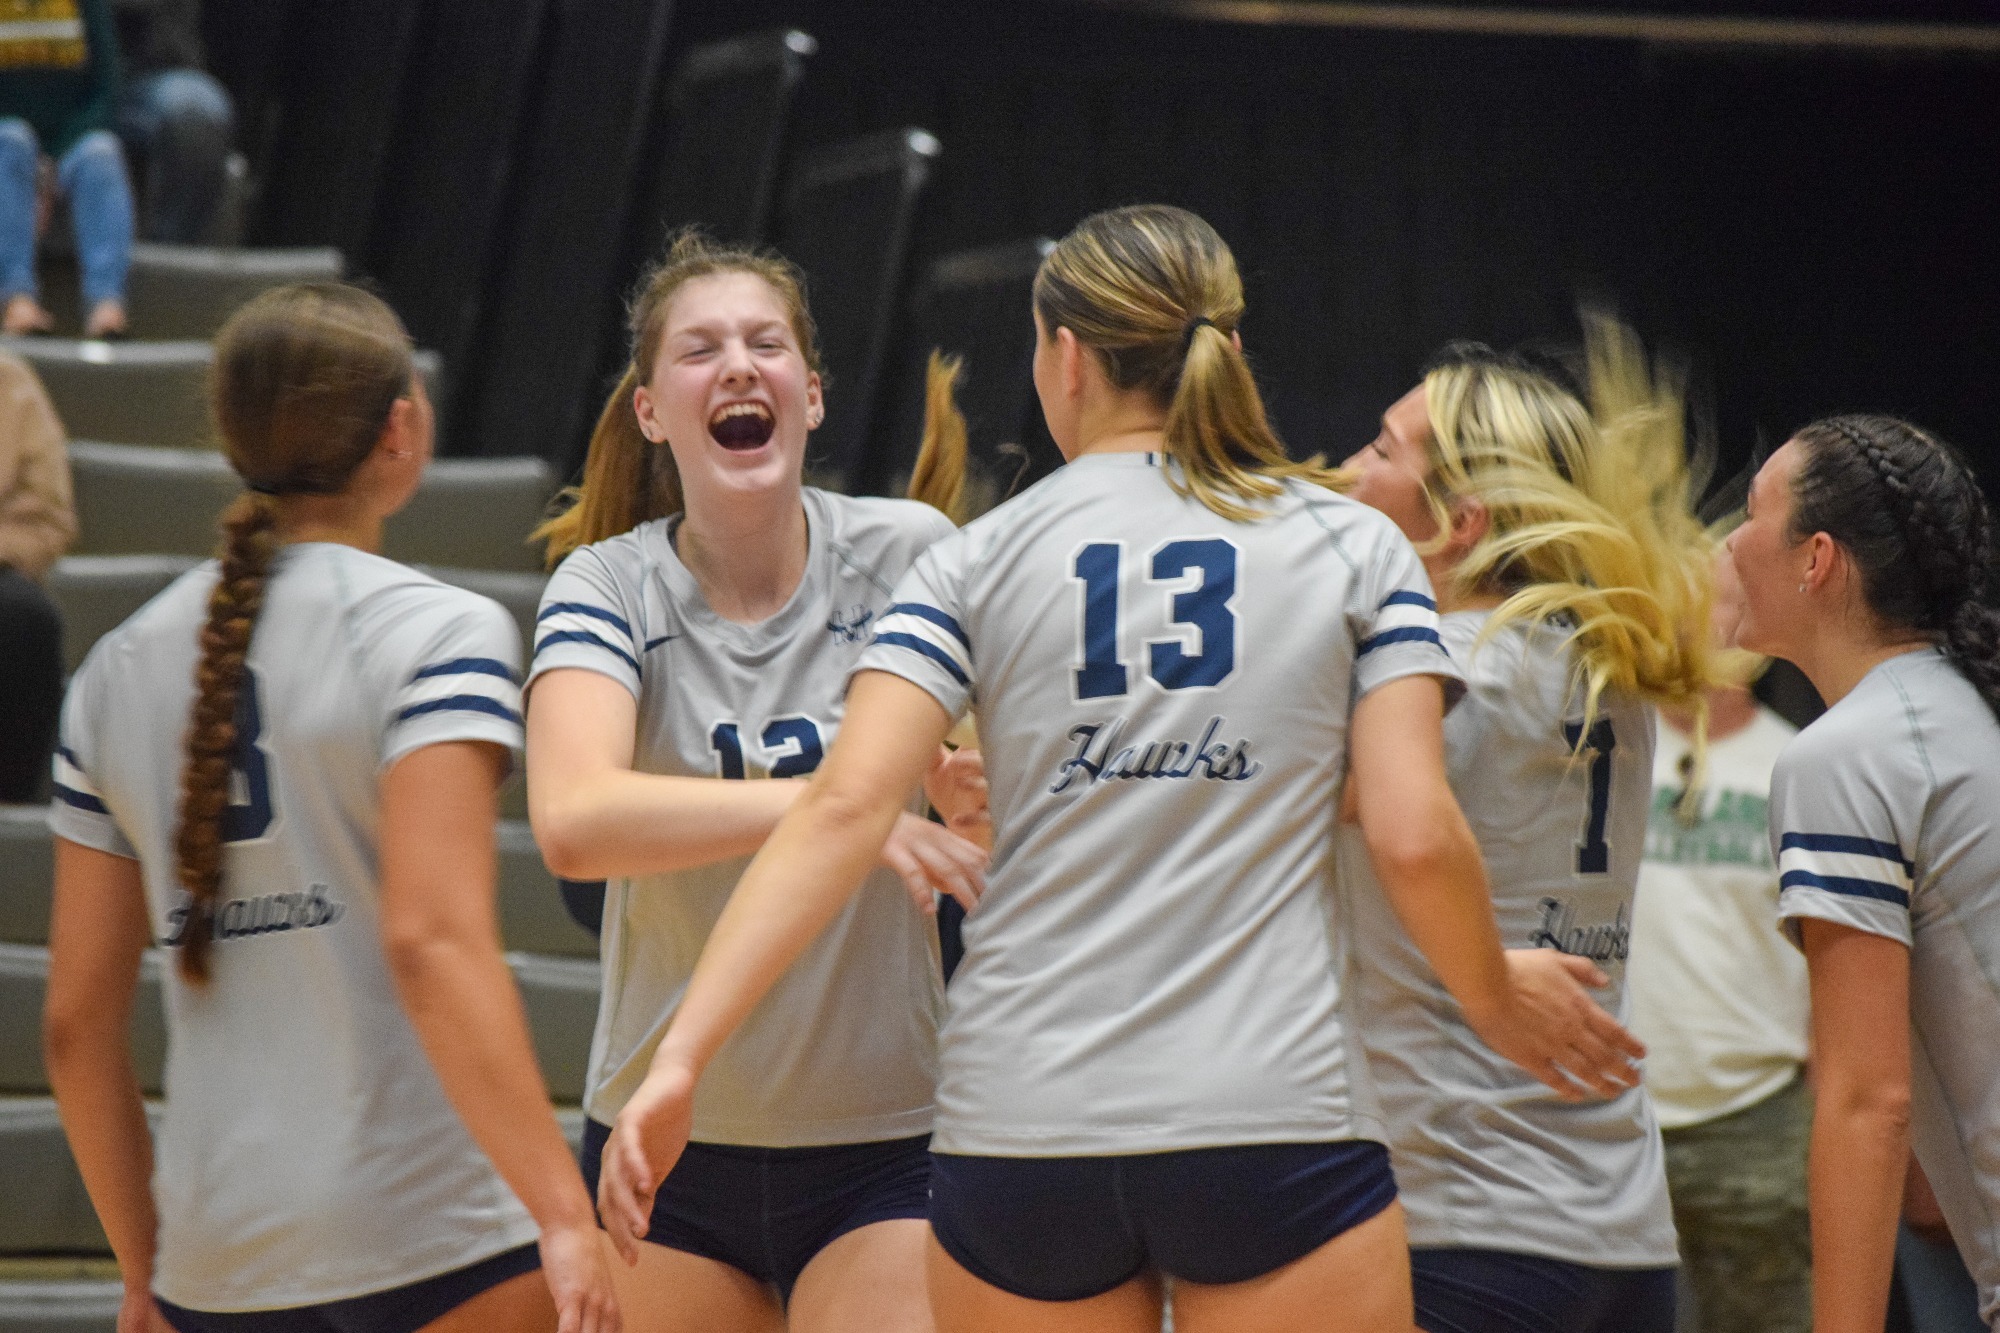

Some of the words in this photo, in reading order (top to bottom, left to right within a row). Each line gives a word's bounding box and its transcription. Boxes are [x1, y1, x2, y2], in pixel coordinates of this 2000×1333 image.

[1066, 536, 1243, 703] 13
[1049, 715, 1263, 795] Hawks
[1562, 714, 1616, 876] 1
